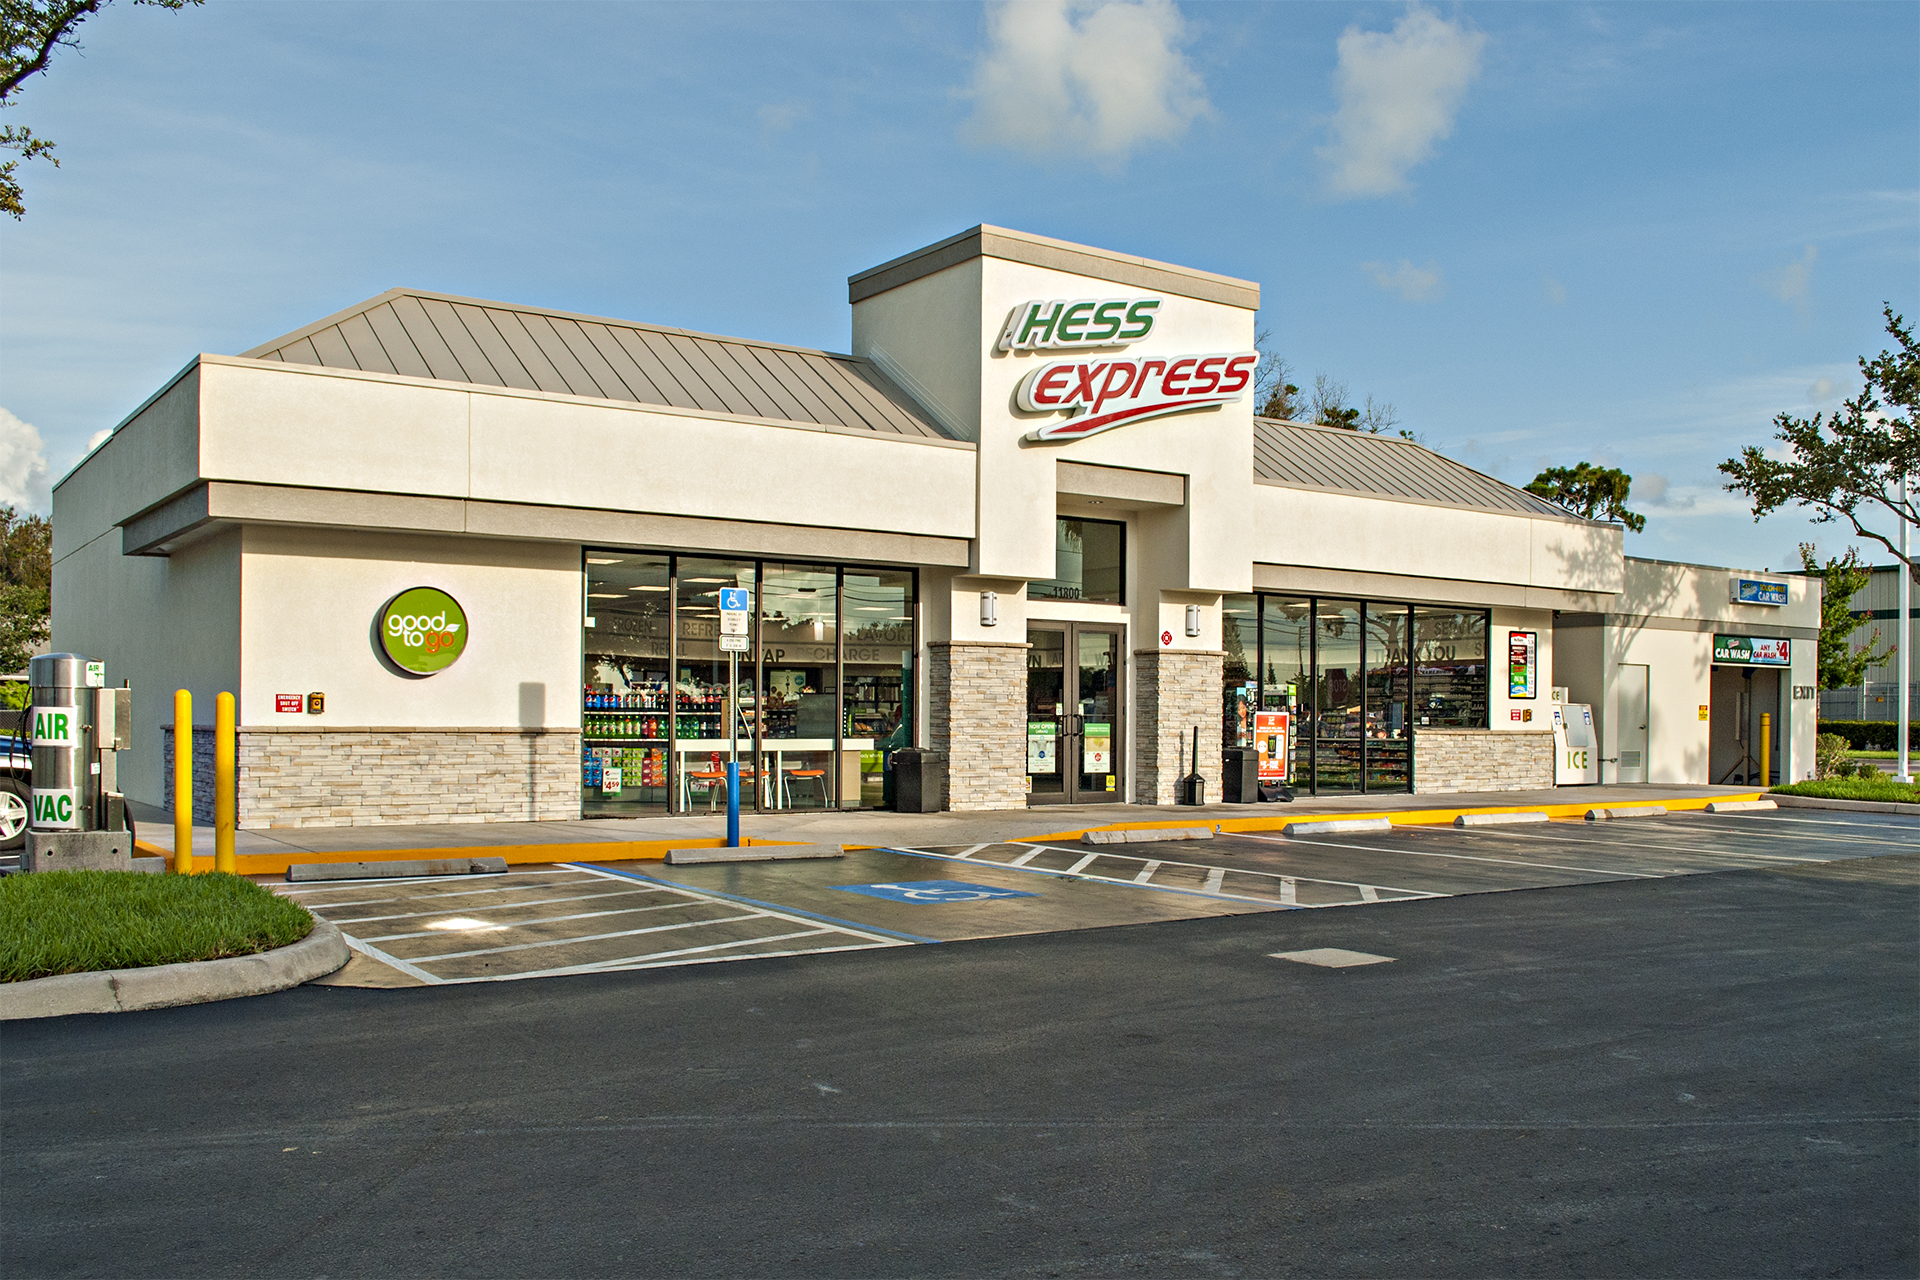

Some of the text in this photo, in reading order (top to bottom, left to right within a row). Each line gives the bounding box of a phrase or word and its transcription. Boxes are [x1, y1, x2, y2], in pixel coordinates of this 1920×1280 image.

[1017, 300, 1161, 343] HESS
[1034, 355, 1257, 414] EXPRESS
[1053, 586, 1080, 600] 11800
[1758, 591, 1769, 601] CAR
[1770, 592, 1786, 602] WASH
[388, 611, 446, 637] good
[612, 617, 652, 634] FROZEN
[682, 621, 720, 637] REFRE
[1433, 620, 1484, 636] SERVIC
[403, 629, 454, 653] to go
[651, 641, 688, 656] REFLL
[762, 649, 786, 662] AP
[1715, 648, 1751, 659] CAR WASH
[1776, 640, 1788, 660] $4
[88, 664, 99, 672] AIR
[1551, 690, 1560, 700] CE
[1793, 685, 1817, 700] EXIT
[35, 713, 69, 740] AIR
[1567, 751, 1588, 769] ICE
[33, 794, 73, 822] VAC
